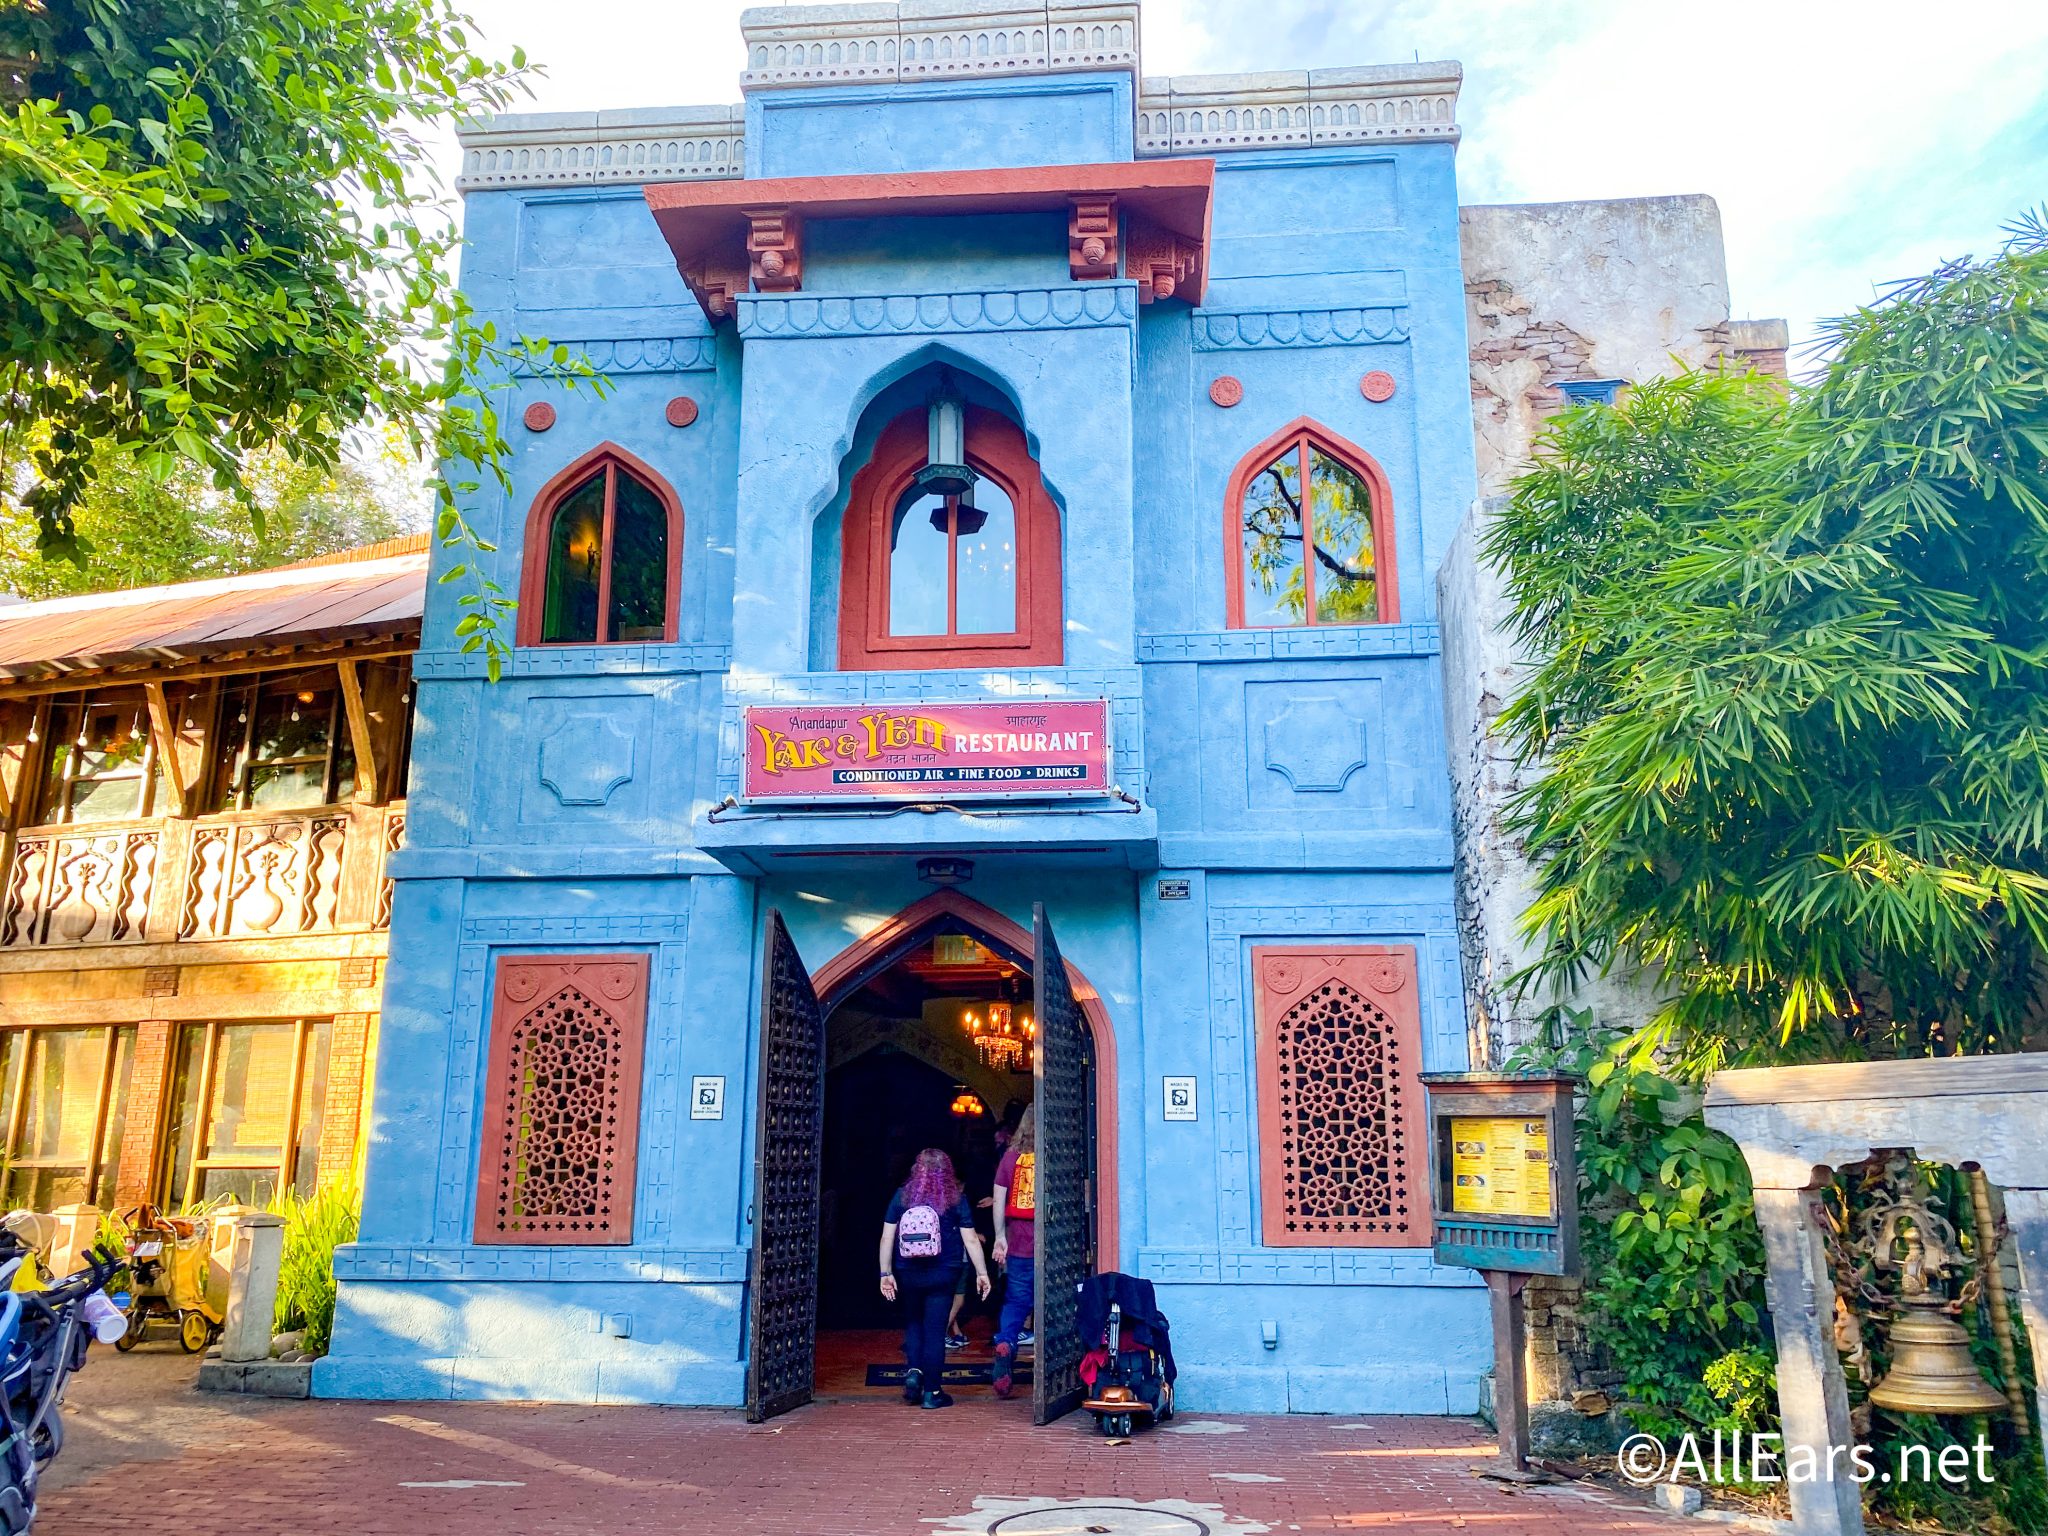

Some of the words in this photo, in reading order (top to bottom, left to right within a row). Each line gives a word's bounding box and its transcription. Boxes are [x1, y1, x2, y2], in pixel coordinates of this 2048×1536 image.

[789, 715, 848, 733] Anandapur
[754, 724, 831, 774] YAK
[836, 734, 859, 762] &
[858, 712, 947, 759] YETI
[955, 731, 1094, 753] RESTAURANT
[839, 771, 921, 782] CONDITIONED
[924, 770, 944, 780] AIR
[958, 769, 985, 779] FINE
[988, 768, 1022, 779] FOOD
[1036, 767, 1080, 778] DRINKS
